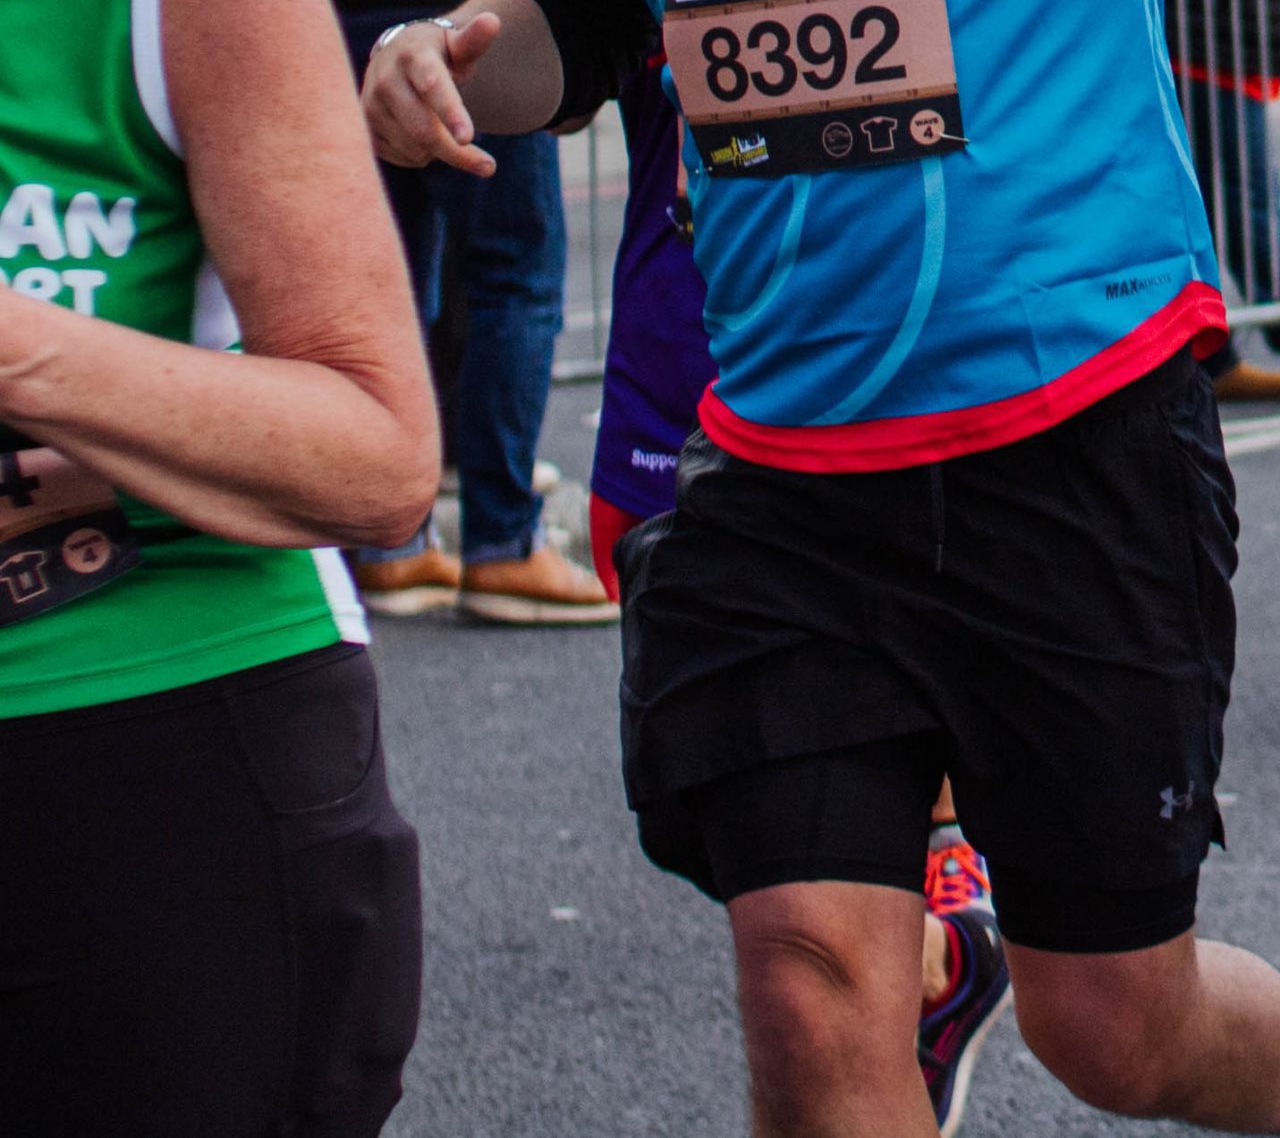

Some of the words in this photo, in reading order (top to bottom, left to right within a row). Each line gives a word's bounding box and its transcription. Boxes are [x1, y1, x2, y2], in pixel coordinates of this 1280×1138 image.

[701, 5, 908, 103] 8392
[914, 117, 940, 127] WAVE
[923, 126, 934, 139] 4
